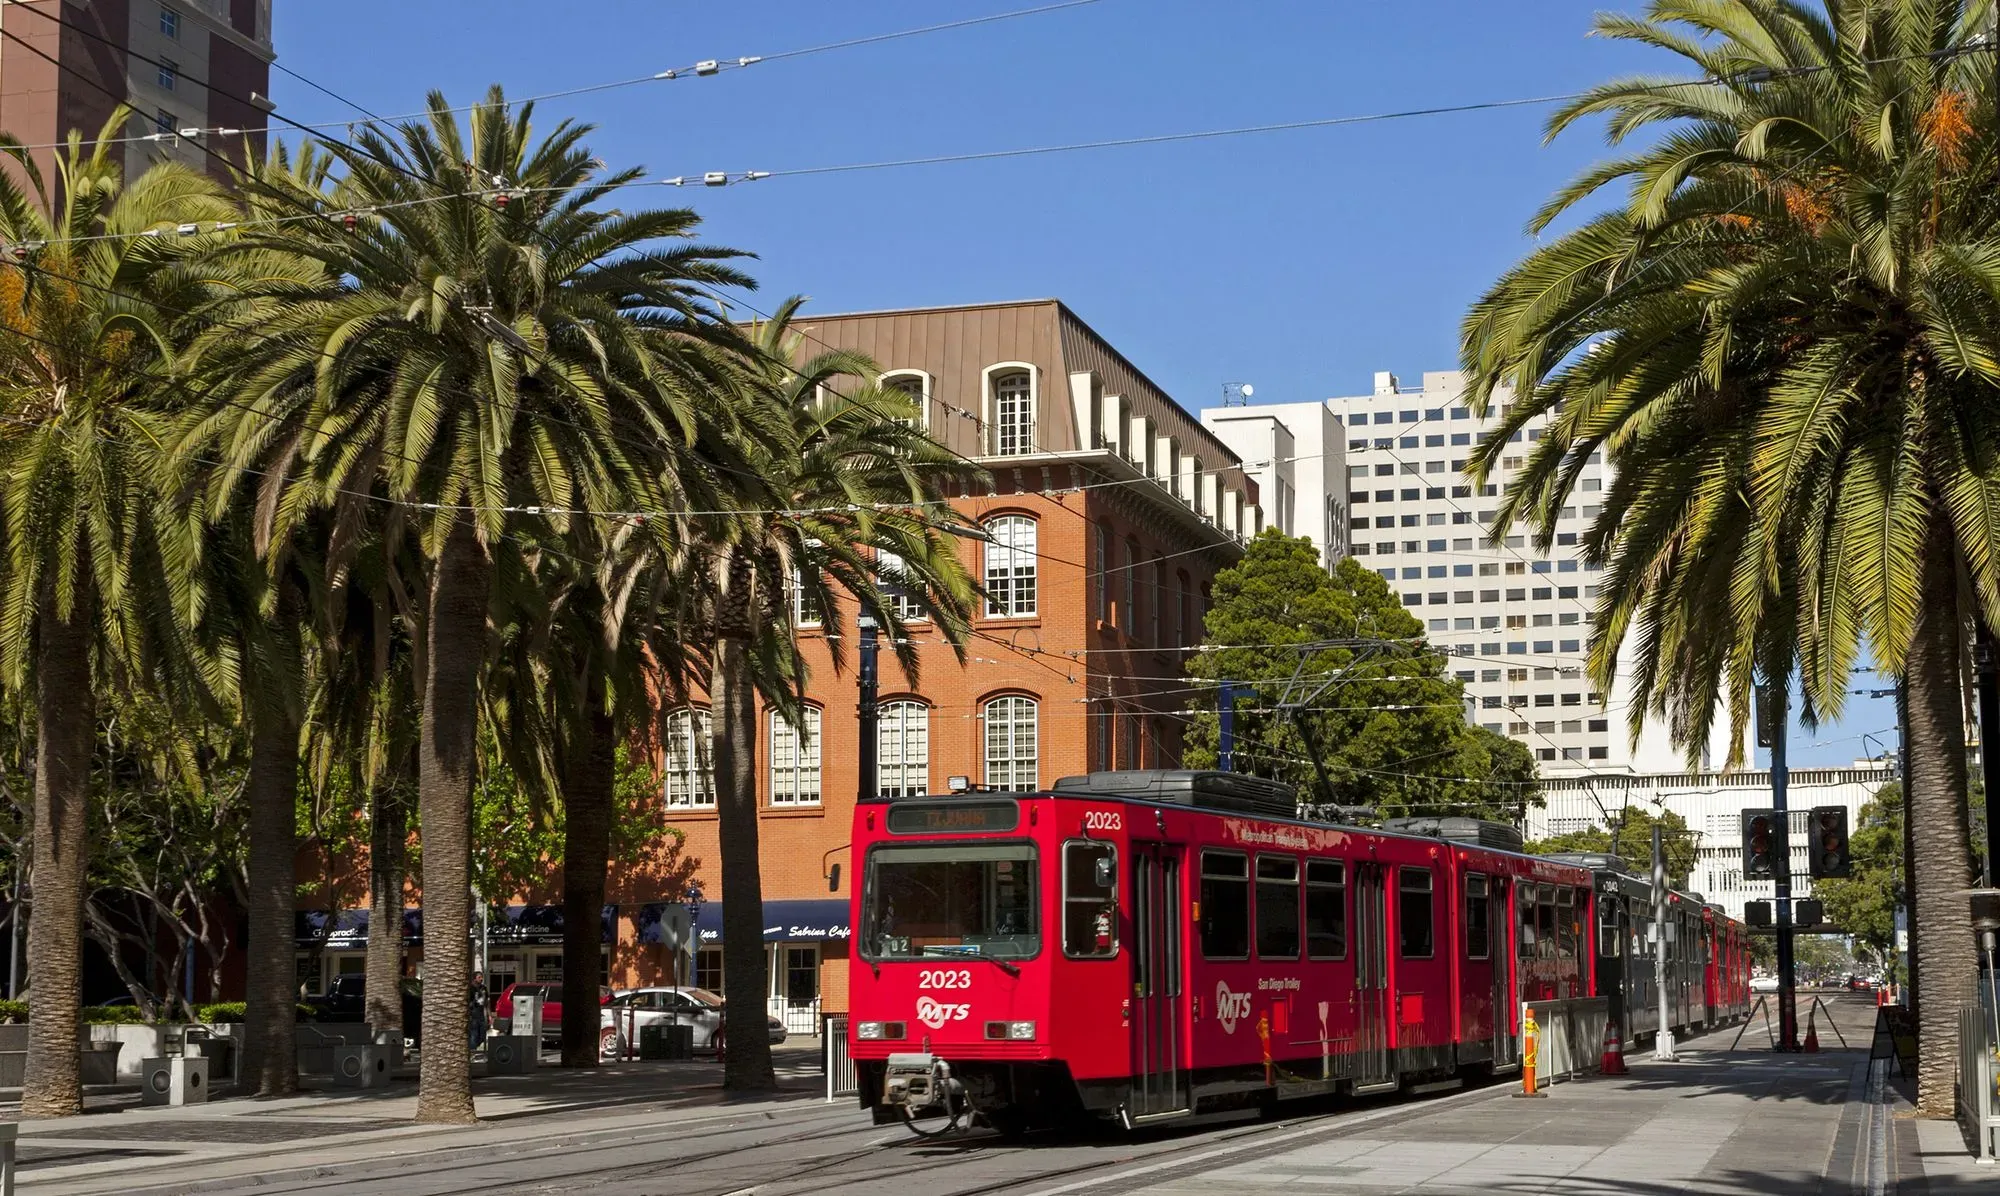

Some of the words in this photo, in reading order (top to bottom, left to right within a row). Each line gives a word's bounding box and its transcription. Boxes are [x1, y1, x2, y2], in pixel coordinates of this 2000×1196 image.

[1085, 811, 1122, 831] 2023
[789, 926, 827, 938] Sabrina
[919, 970, 972, 989] 2023
[1258, 977, 1268, 990] San
[1269, 977, 1284, 992] Diego
[1284, 977, 1301, 991] Trolley
[917, 1003, 971, 1021] MTS
[1217, 992, 1252, 1019] MTS
